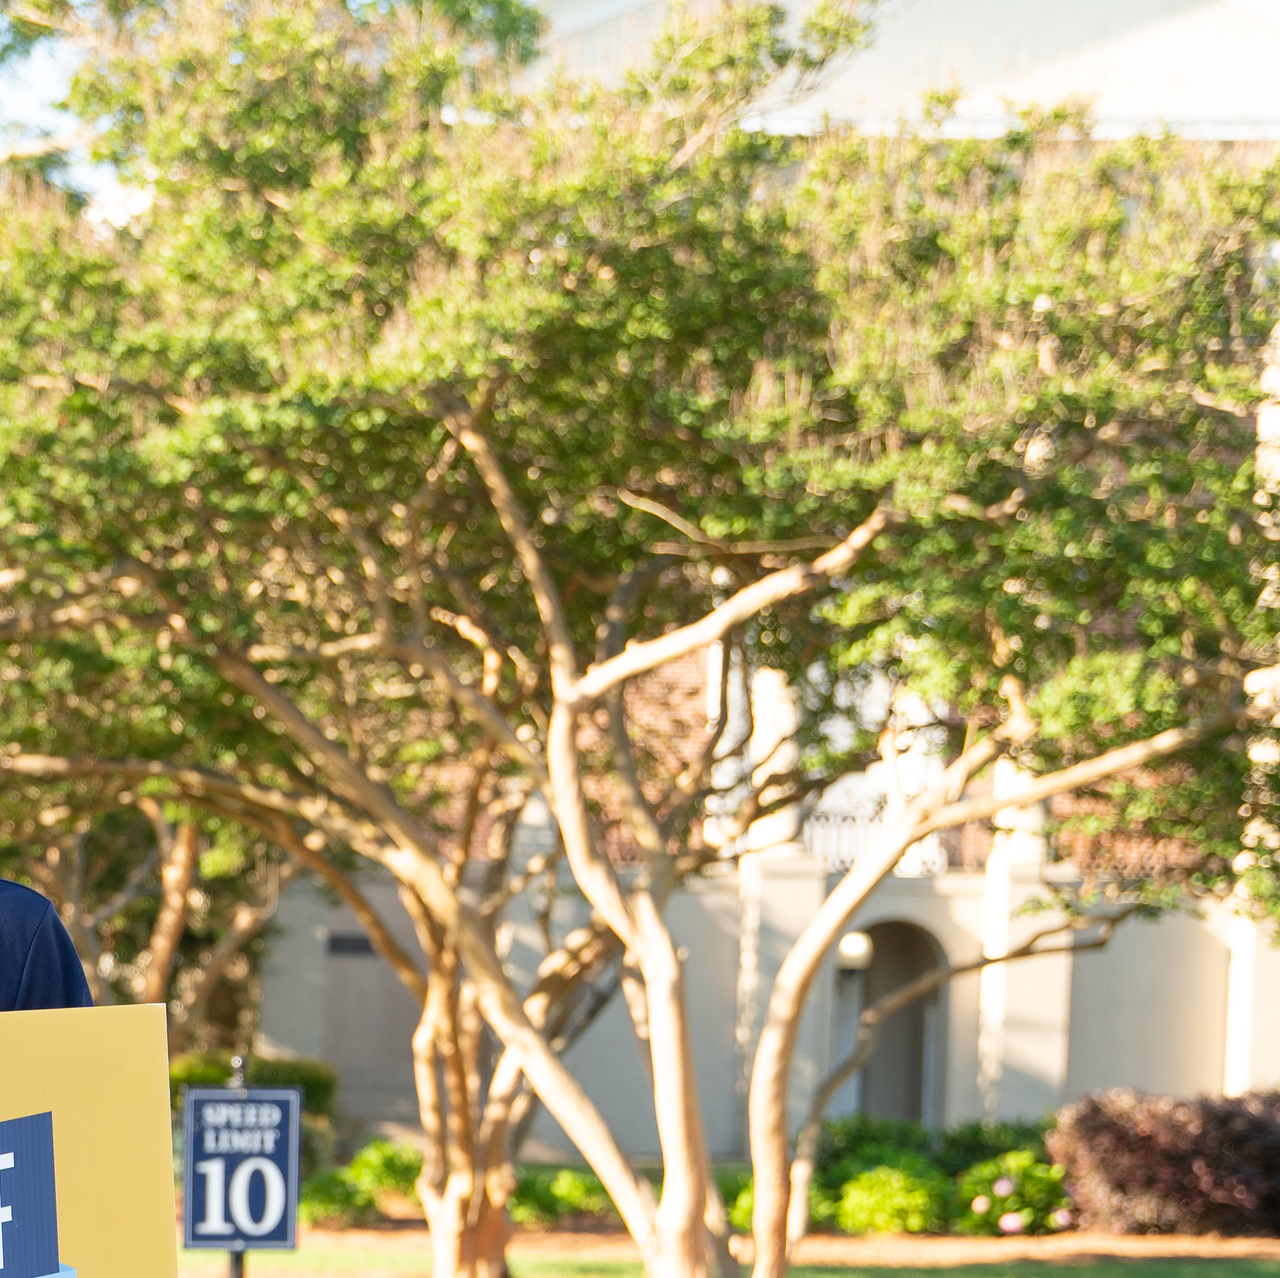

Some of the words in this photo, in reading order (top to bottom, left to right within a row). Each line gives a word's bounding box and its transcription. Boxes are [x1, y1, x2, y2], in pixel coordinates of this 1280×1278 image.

[202, 1103, 282, 1128] SPEED
[204, 1128, 278, 1154] LIMIT
[194, 1156, 286, 1237] 10
